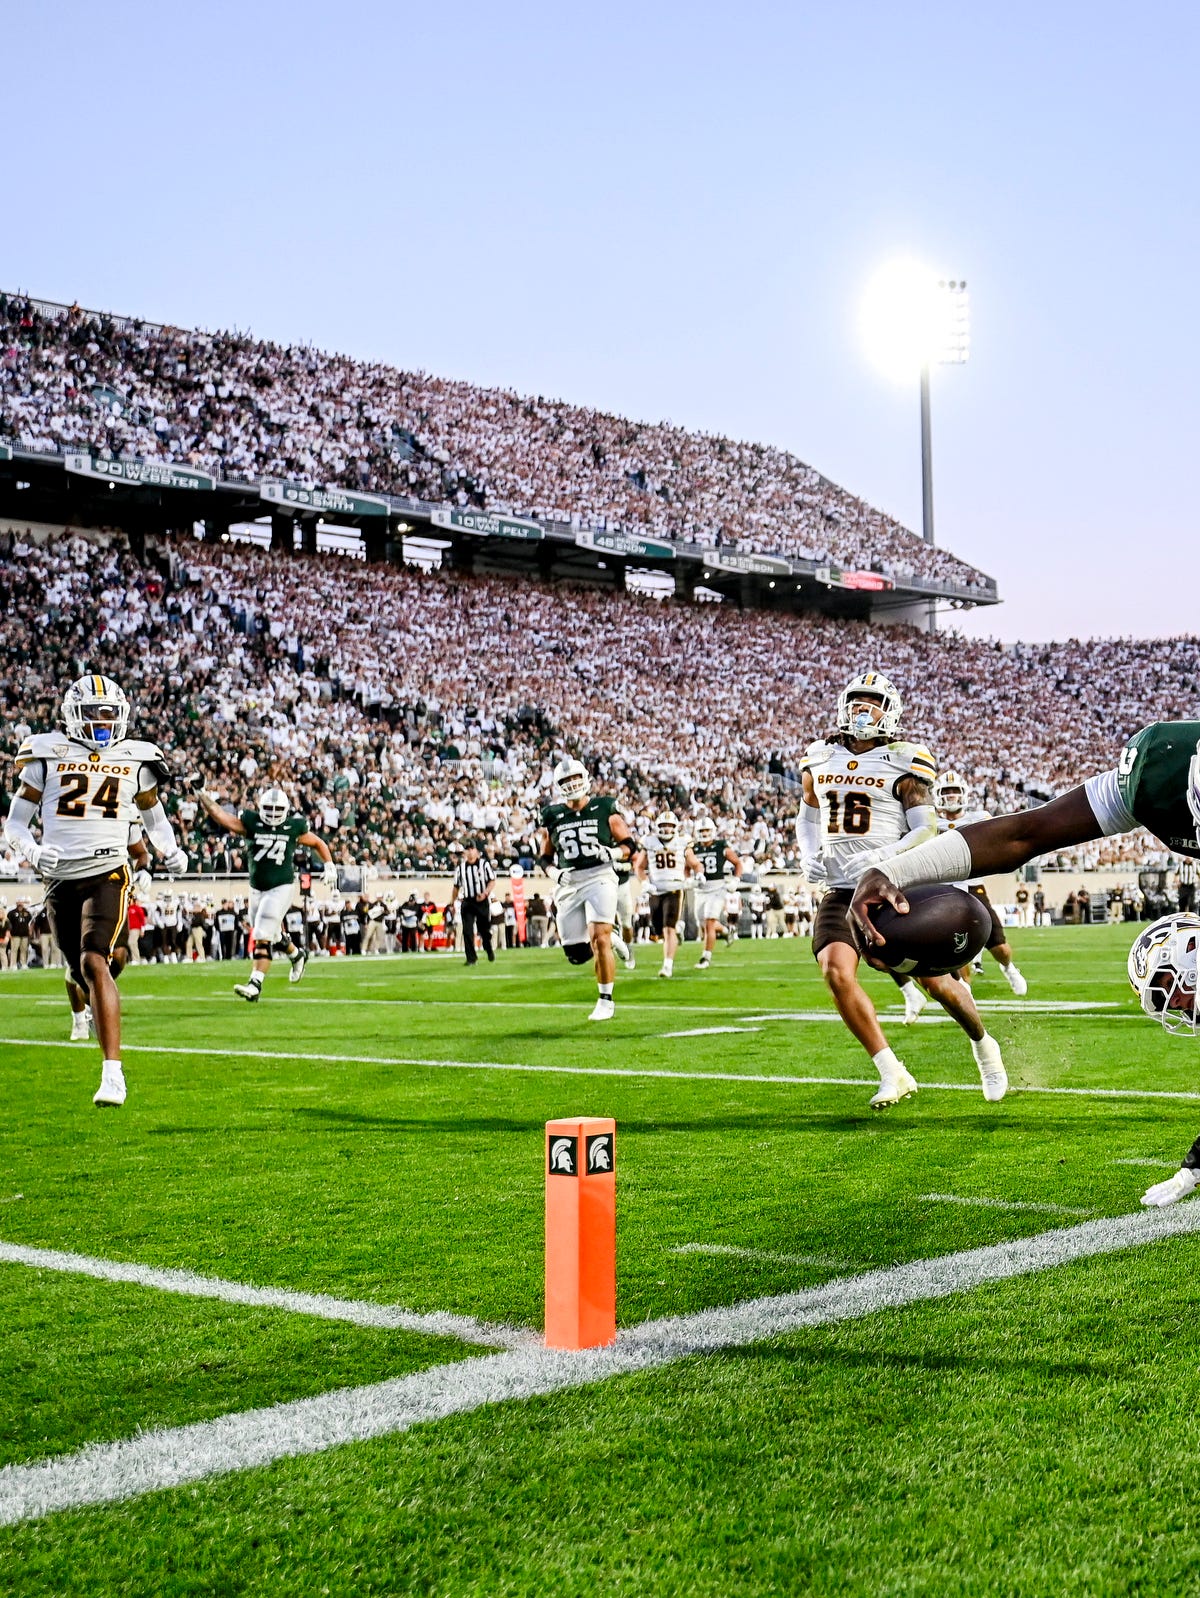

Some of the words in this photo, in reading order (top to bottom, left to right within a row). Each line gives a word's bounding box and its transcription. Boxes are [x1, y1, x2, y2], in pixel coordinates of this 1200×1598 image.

[96, 460, 122, 476] 90
[126, 471, 199, 489] WEBSTER
[477, 522, 499, 533] VAN
[503, 525, 530, 538] PELT
[56, 763, 131, 775] BRONCOS
[817, 774, 885, 788] BRONCOS
[56, 773, 120, 819] 24
[825, 790, 872, 834] 16
[558, 826, 599, 860] 65
[253, 838, 287, 866] 74
[655, 852, 676, 869] 96
